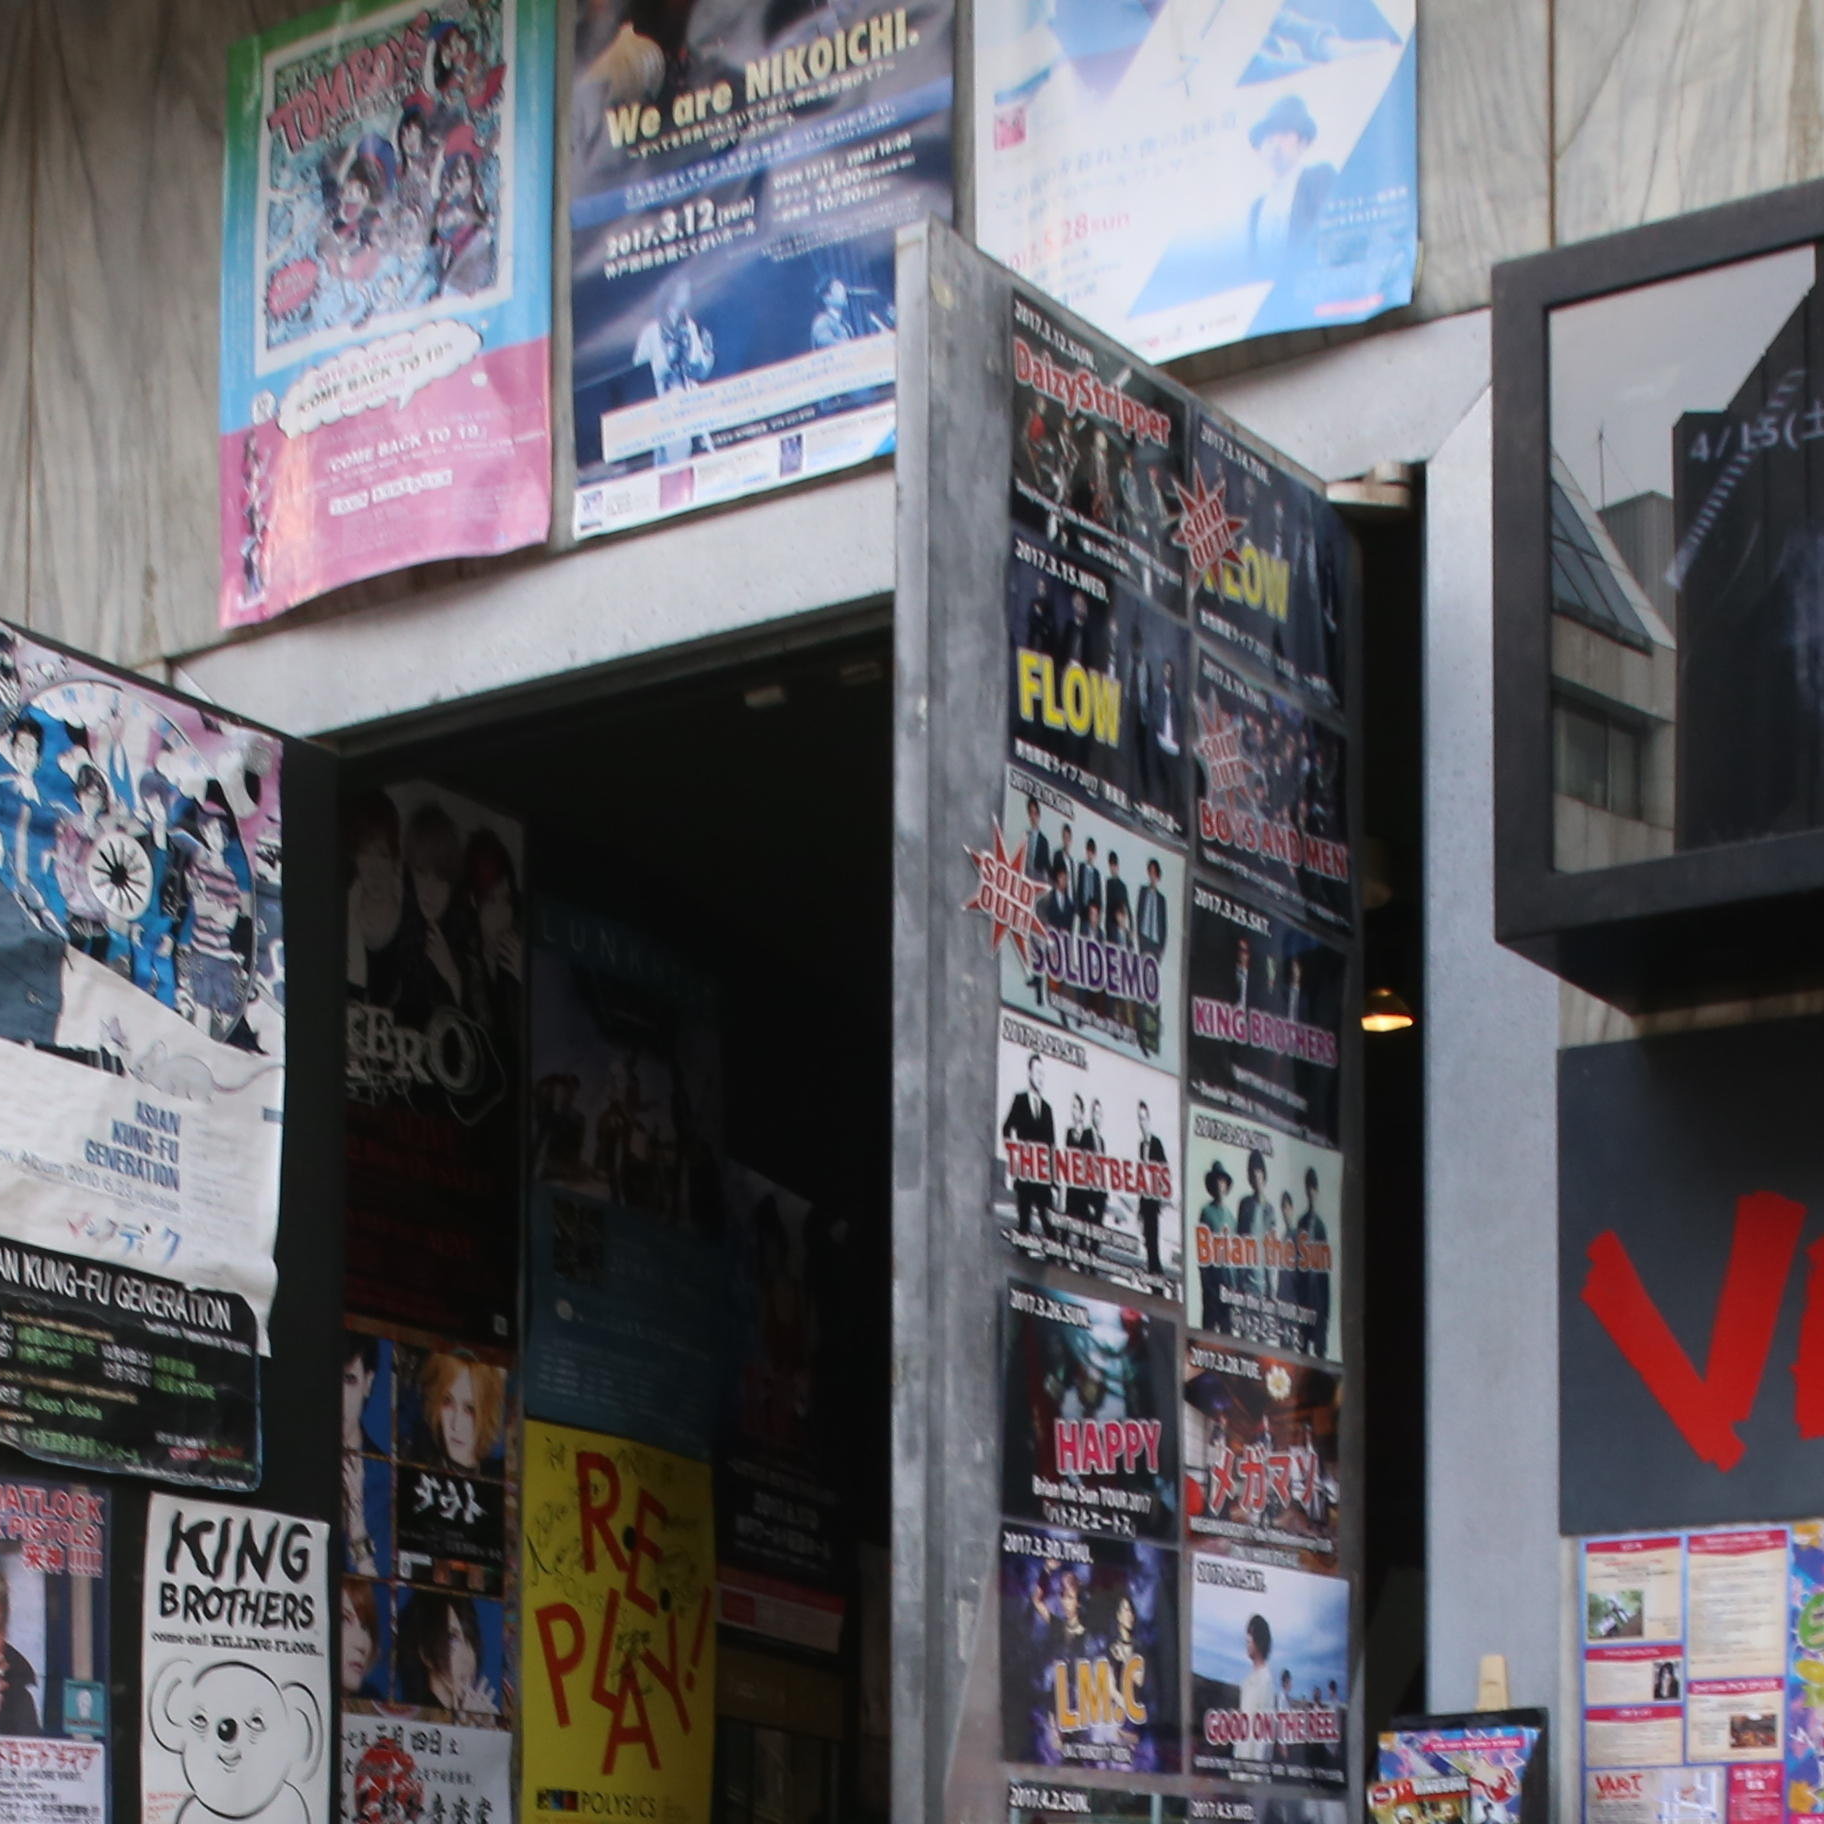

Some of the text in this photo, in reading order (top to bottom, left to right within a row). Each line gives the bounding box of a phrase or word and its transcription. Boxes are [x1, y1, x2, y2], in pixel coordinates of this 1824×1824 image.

[606, 105, 661, 148] We
[672, 83, 733, 127] are
[745, 8, 920, 103] NIKOICHI.
[606, 200, 716, 258] 2017.3.12
[1012, 336, 1172, 448] DaizyStripper
[1182, 496, 1223, 546] SOLD
[1014, 537, 1110, 605] 2017.3.15.WED.
[1190, 526, 1236, 571] OUT!
[1017, 645, 1123, 749] FLOW
[1261, 820, 1303, 868] AND
[1303, 835, 1349, 884] MEN
[980, 856, 1039, 904] SOLD
[979, 888, 1040, 938] OUT!
[1031, 927, 1161, 1007] SOLIDEMO
[1192, 997, 1340, 1069] KING BROTHERS
[111, 1119, 181, 1165] KUNG-FU
[134, 1099, 182, 1136] ASIAN
[20, 1150, 64, 1178] Album
[83, 1139, 181, 1192] GENERATION
[1002, 1140, 1173, 1201] THE NEATBEATS
[1194, 1223, 1259, 1269] Brian
[1263, 1227, 1295, 1270] the
[1297, 1229, 1333, 1273] Sun
[21, 1252, 111, 1306] KUNG-FU
[114, 1270, 233, 1333] GENERATION
[1053, 1417, 1162, 1476] HAPPY
[6, 1513, 104, 1554] PISTOLS)
[165, 1508, 313, 1587] KING
[159, 1581, 315, 1632] BROTHERS
[210, 1634, 275, 1657] KILLING
[1055, 1653, 1149, 1733] LM.C
[1203, 1705, 1341, 1745] GOOD ON THE REEL
[582, 1788, 658, 1820] POLYSICS
